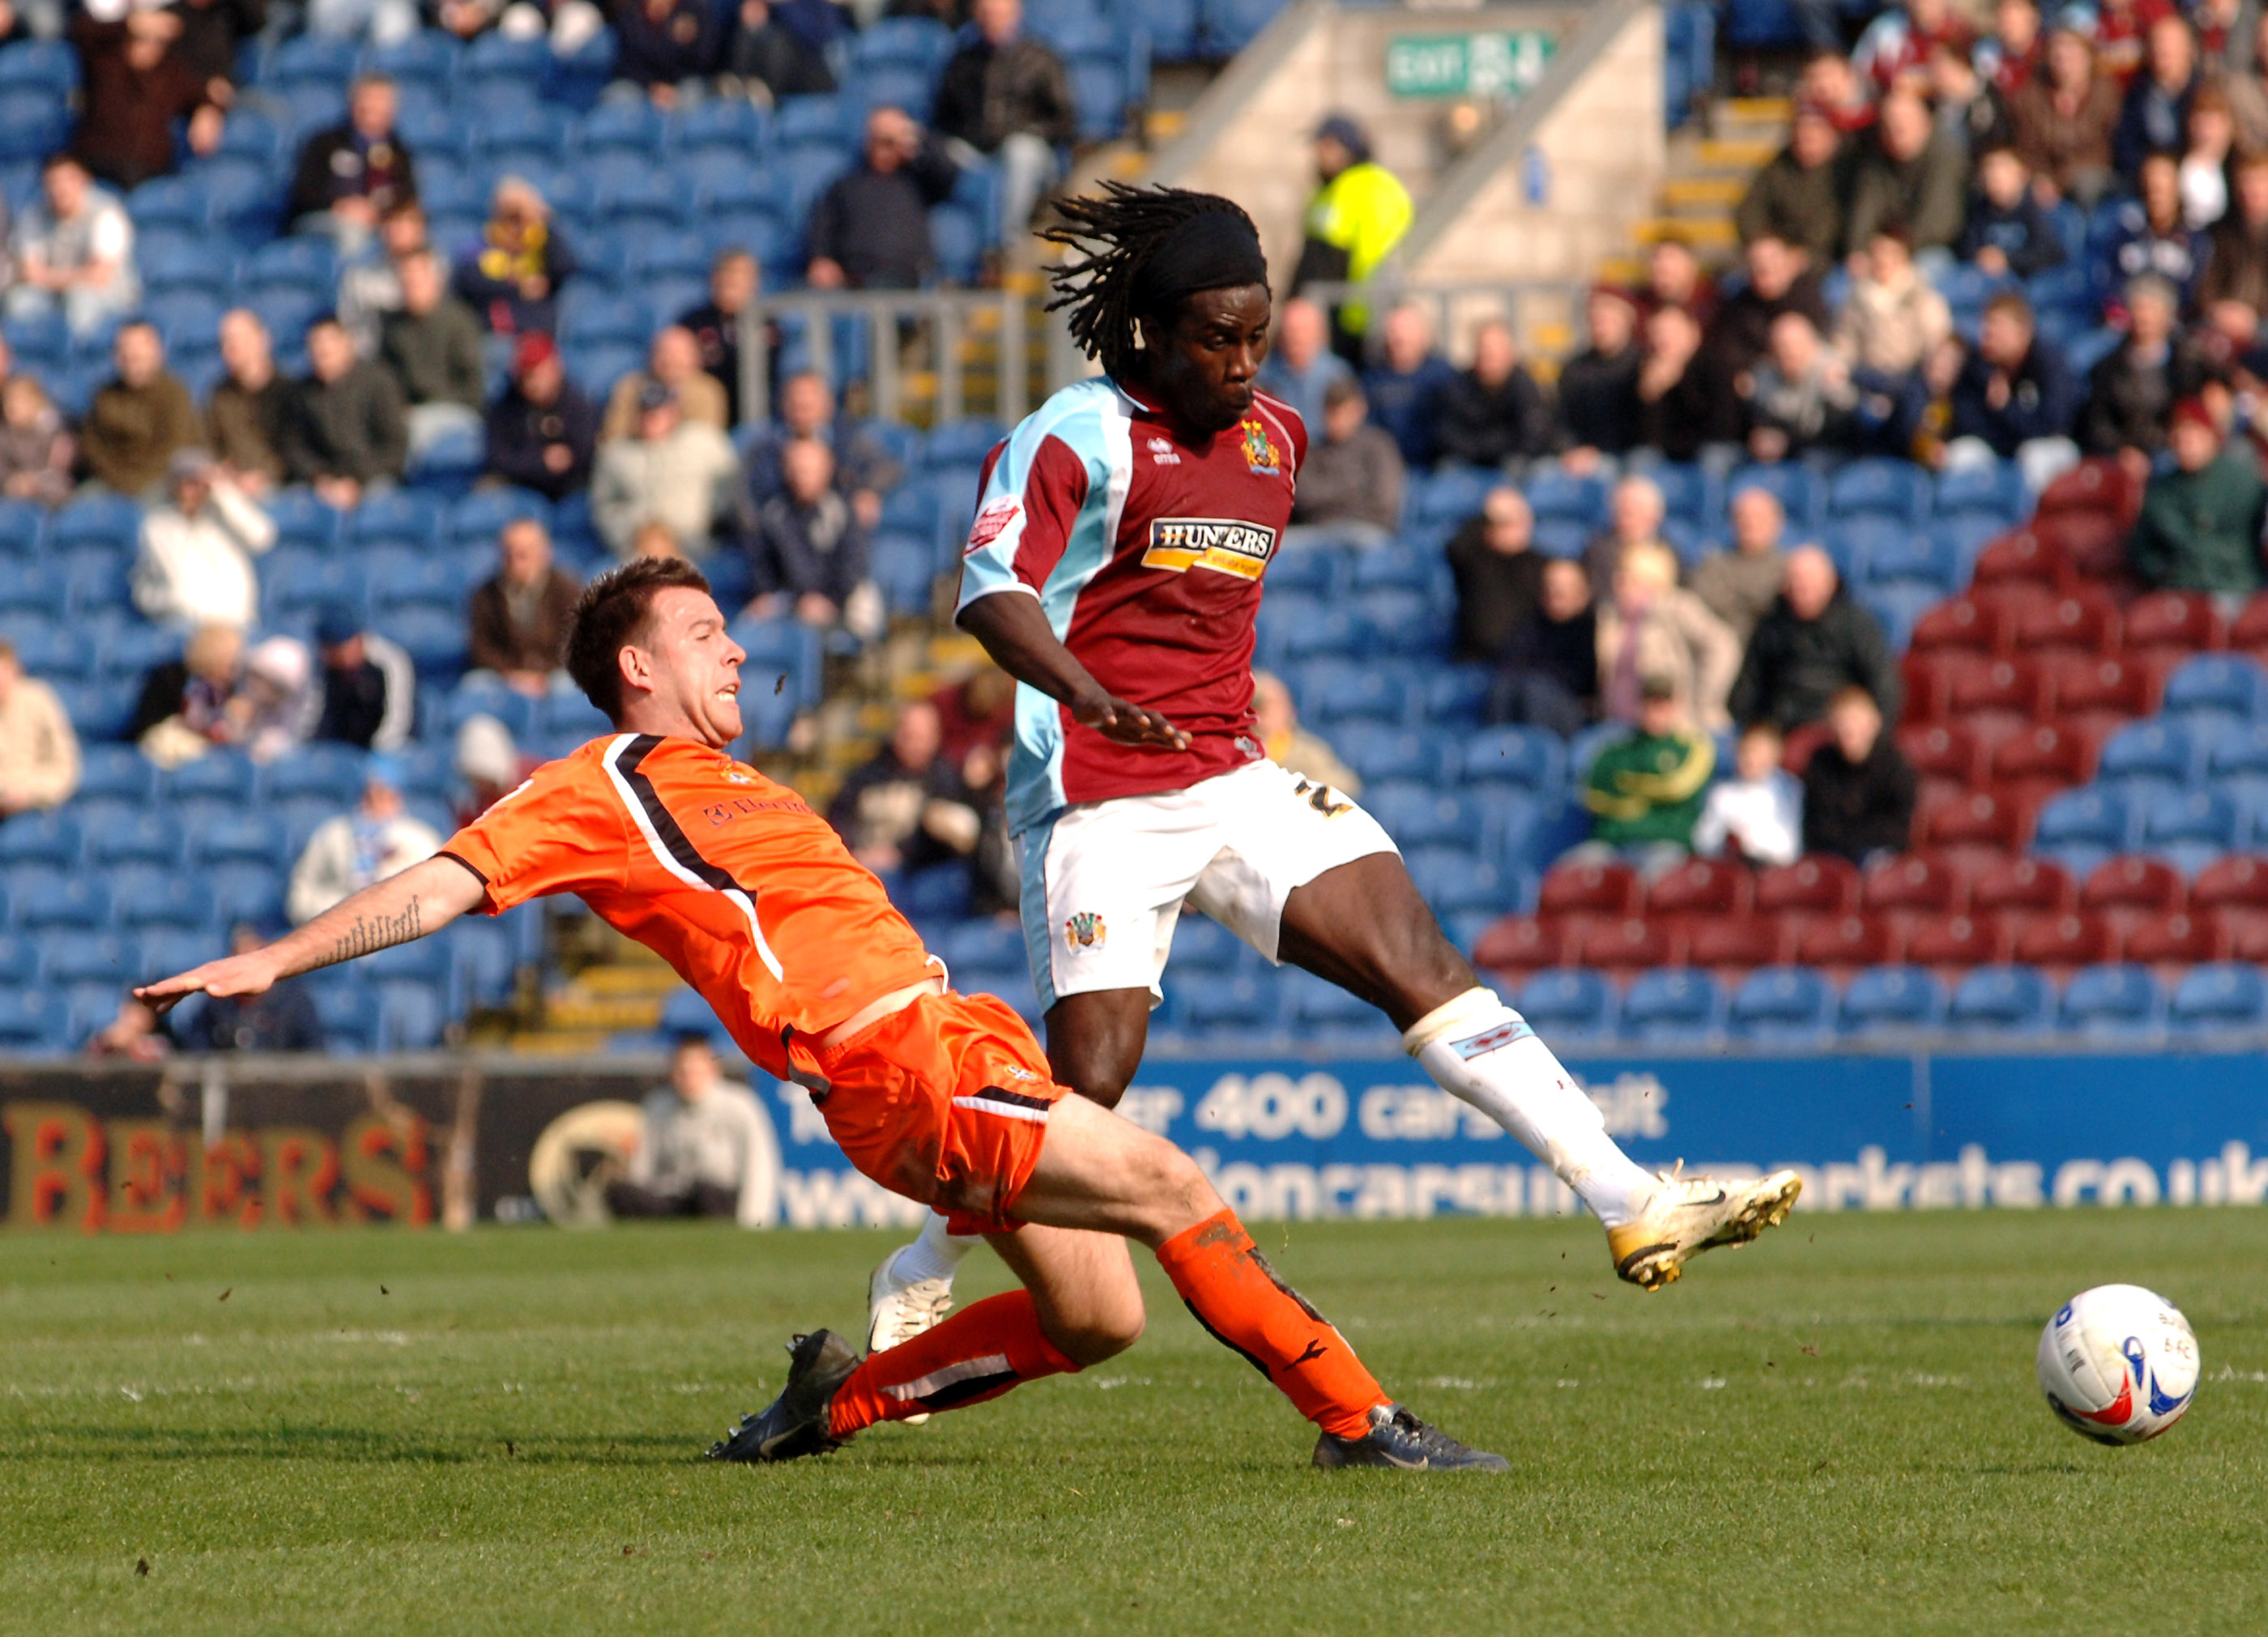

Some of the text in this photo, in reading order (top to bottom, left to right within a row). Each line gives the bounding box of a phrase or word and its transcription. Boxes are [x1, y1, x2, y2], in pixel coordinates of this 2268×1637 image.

[1194, 1071, 1349, 1140] 400
[1357, 1083, 1511, 1141] cars
[2, 1099, 434, 1236] BEERS
